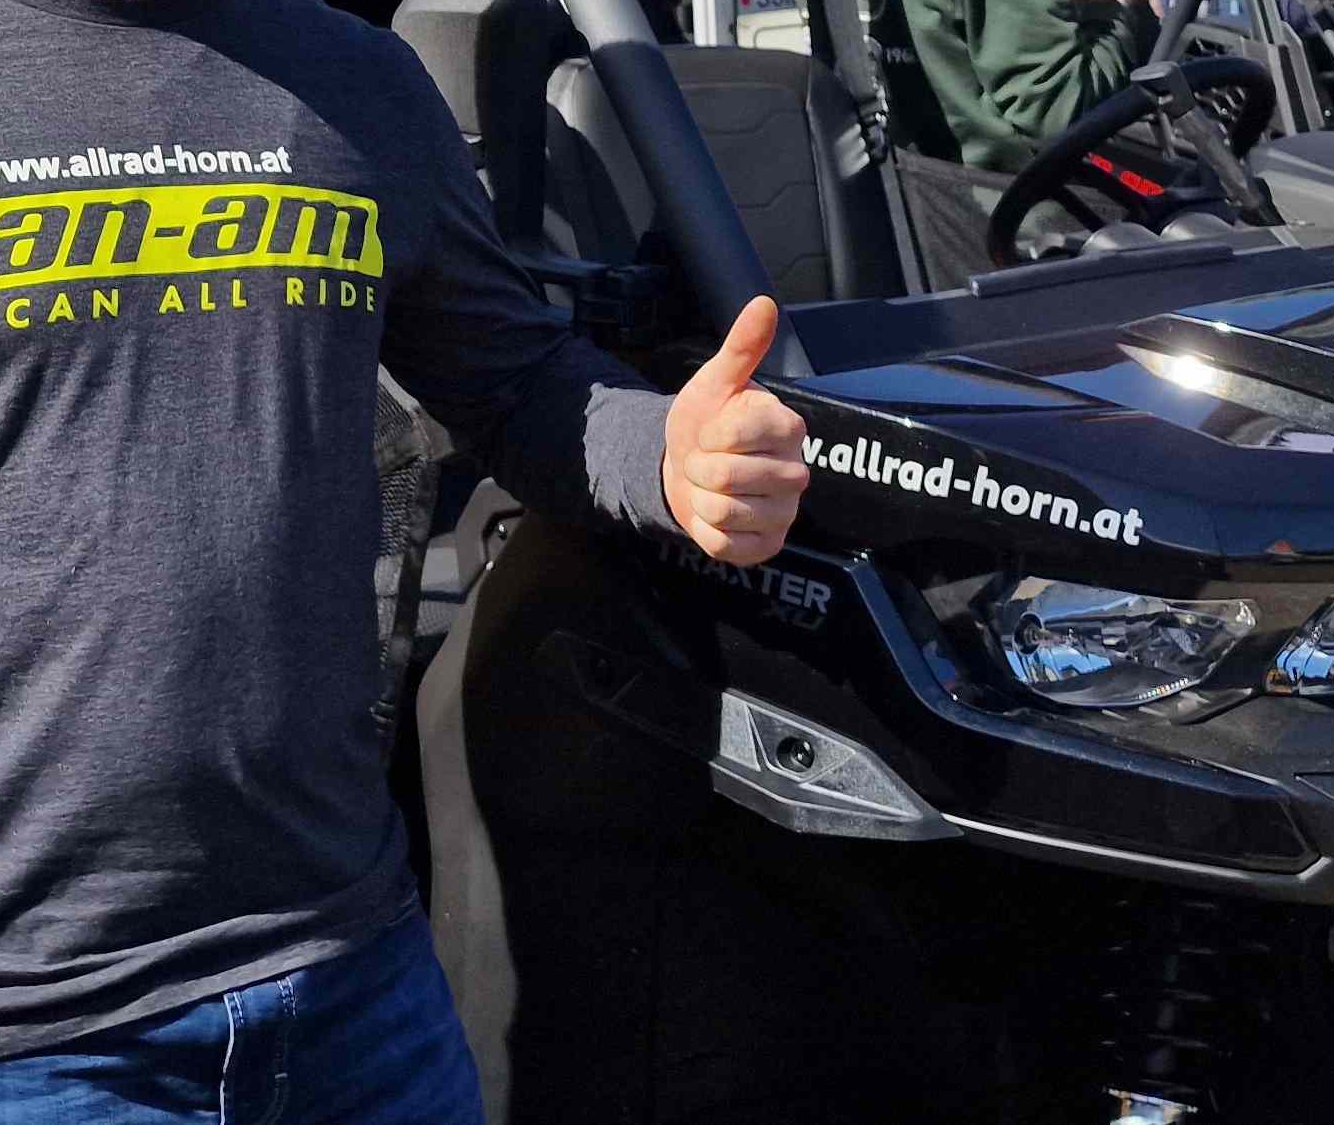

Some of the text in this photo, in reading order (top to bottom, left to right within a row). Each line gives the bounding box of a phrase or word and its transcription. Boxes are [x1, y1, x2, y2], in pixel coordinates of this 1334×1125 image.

[6, 288, 120, 330] CAN
[160, 281, 248, 314] ALL
[285, 277, 377, 313] RIDE
